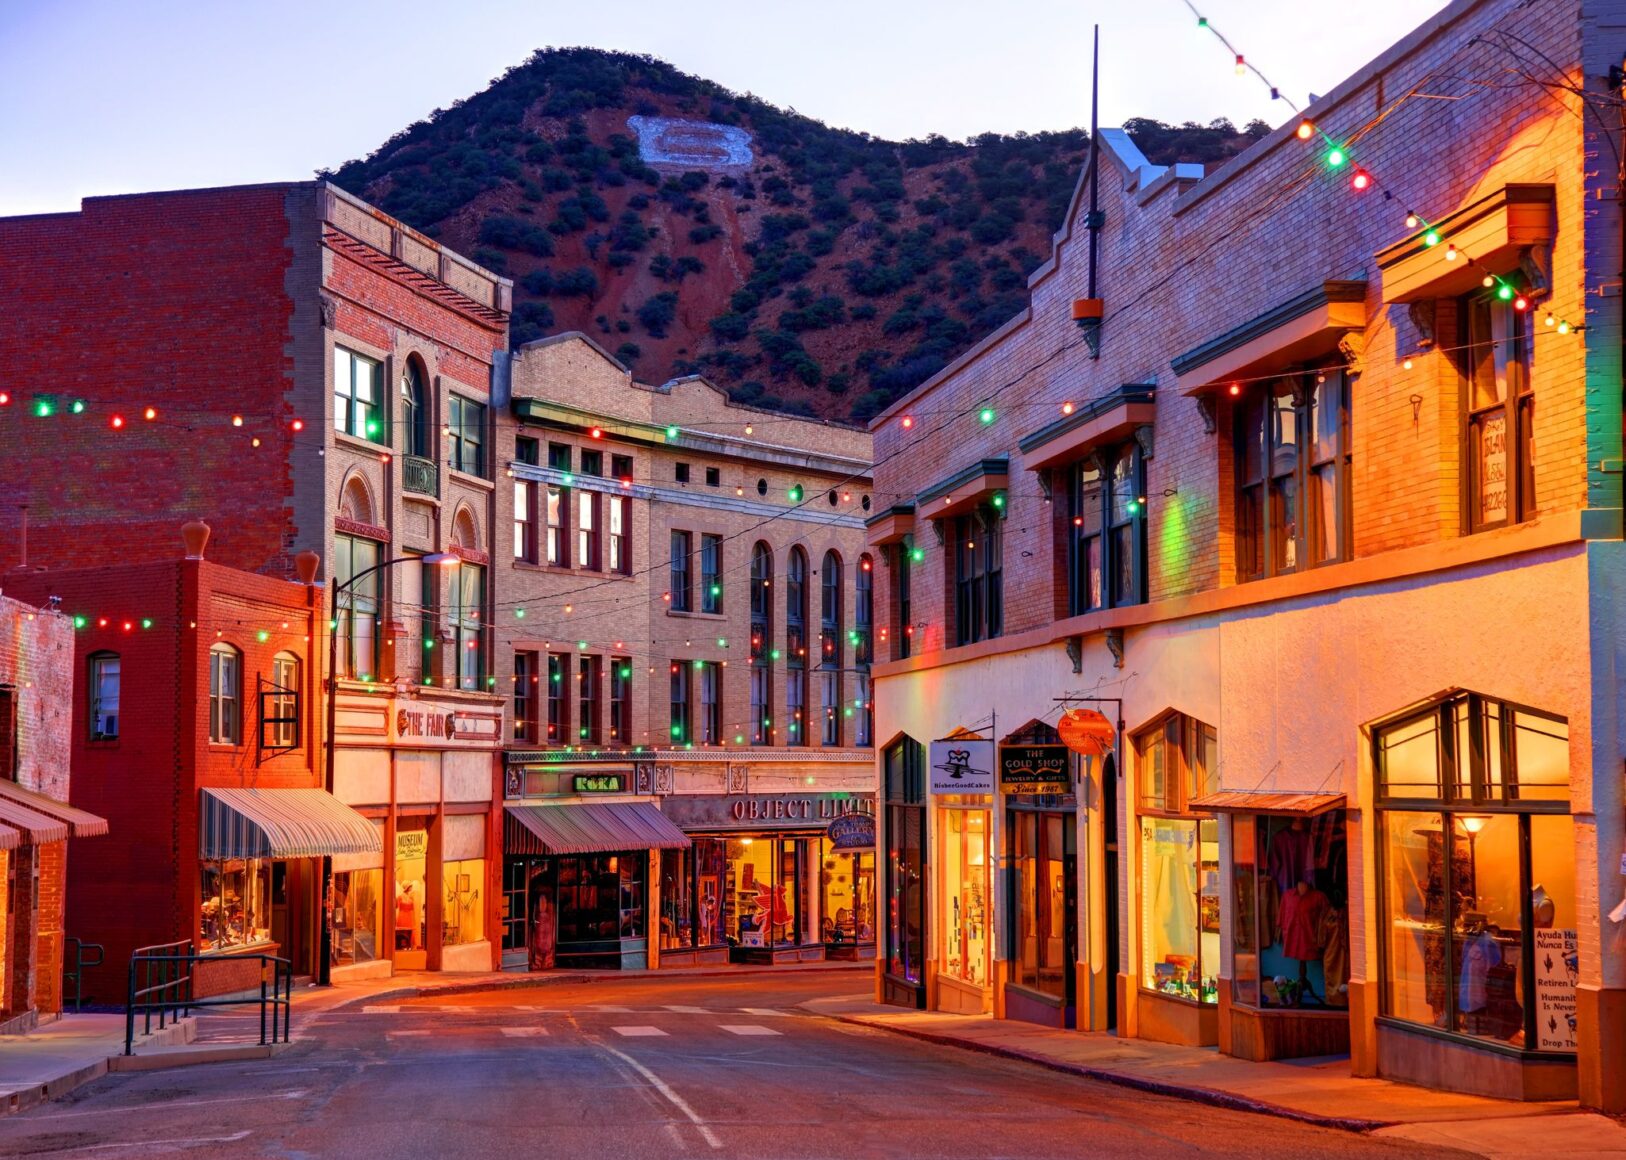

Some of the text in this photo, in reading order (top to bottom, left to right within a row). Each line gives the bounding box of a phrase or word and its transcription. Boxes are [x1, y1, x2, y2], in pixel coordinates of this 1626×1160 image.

[407, 711, 444, 737] THE FAIR
[1025, 750, 1044, 758] THE
[1005, 759, 1065, 768] GOLD SHOP
[1012, 783, 1037, 793] Since
[734, 800, 812, 819] OBJECT
[832, 826, 874, 840] GALLERY
[398, 833, 423, 848] MUSEUM
[1537, 931, 1561, 940] Ayuda
[1537, 941, 1574, 949] Nunca Es
[1538, 979, 1568, 987] Retiren
[1544, 1002, 1576, 1011] Is Never
[1542, 1039, 1562, 1048] Drop
